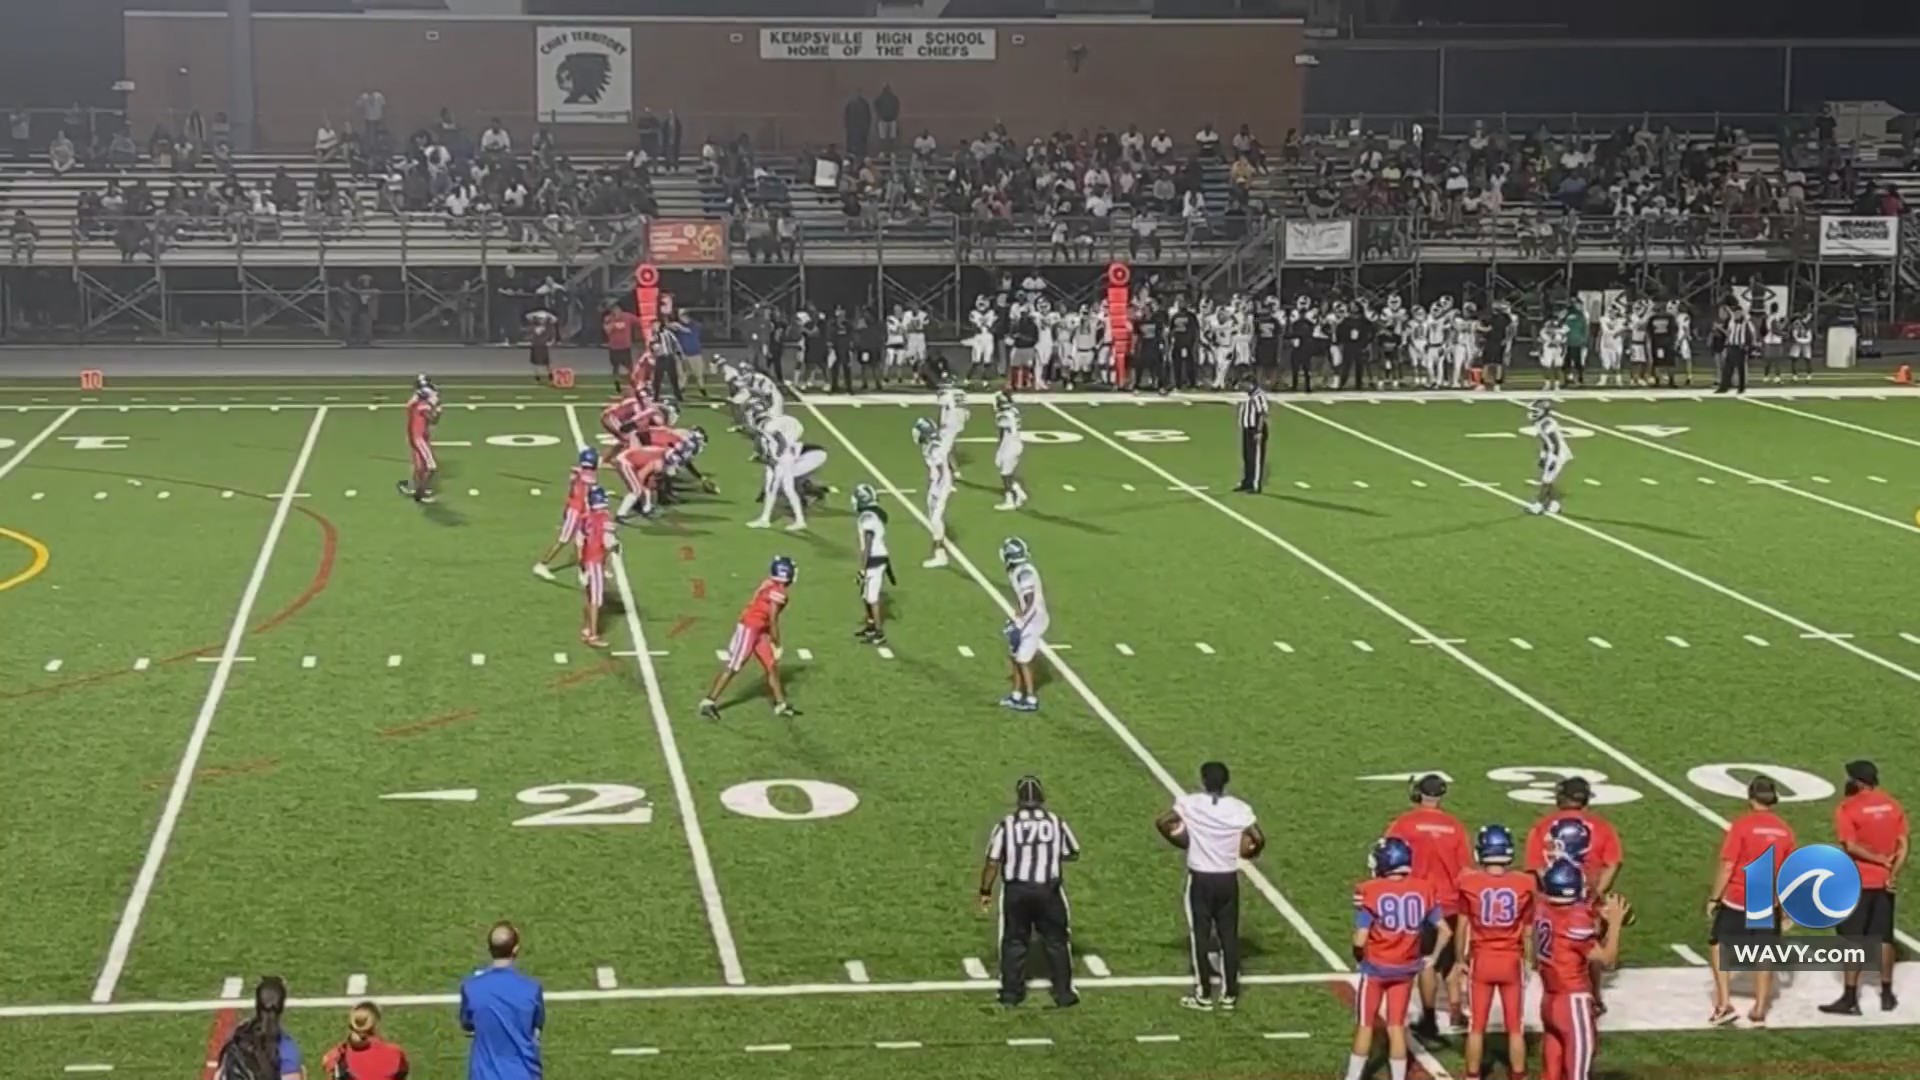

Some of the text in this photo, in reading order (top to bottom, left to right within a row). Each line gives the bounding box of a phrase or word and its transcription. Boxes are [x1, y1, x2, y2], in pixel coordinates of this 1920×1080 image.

[539, 31, 627, 56] CHIEF TERRITORY
[769, 31, 986, 45] KEMPSVILLE HIGH SCHOOL
[787, 45, 970, 57] HOME OF THE CHIEFS
[83, 371, 101, 389] 10
[1014, 818, 1053, 843] 170
[1378, 892, 1425, 935] 80
[1480, 887, 1519, 927] 13
